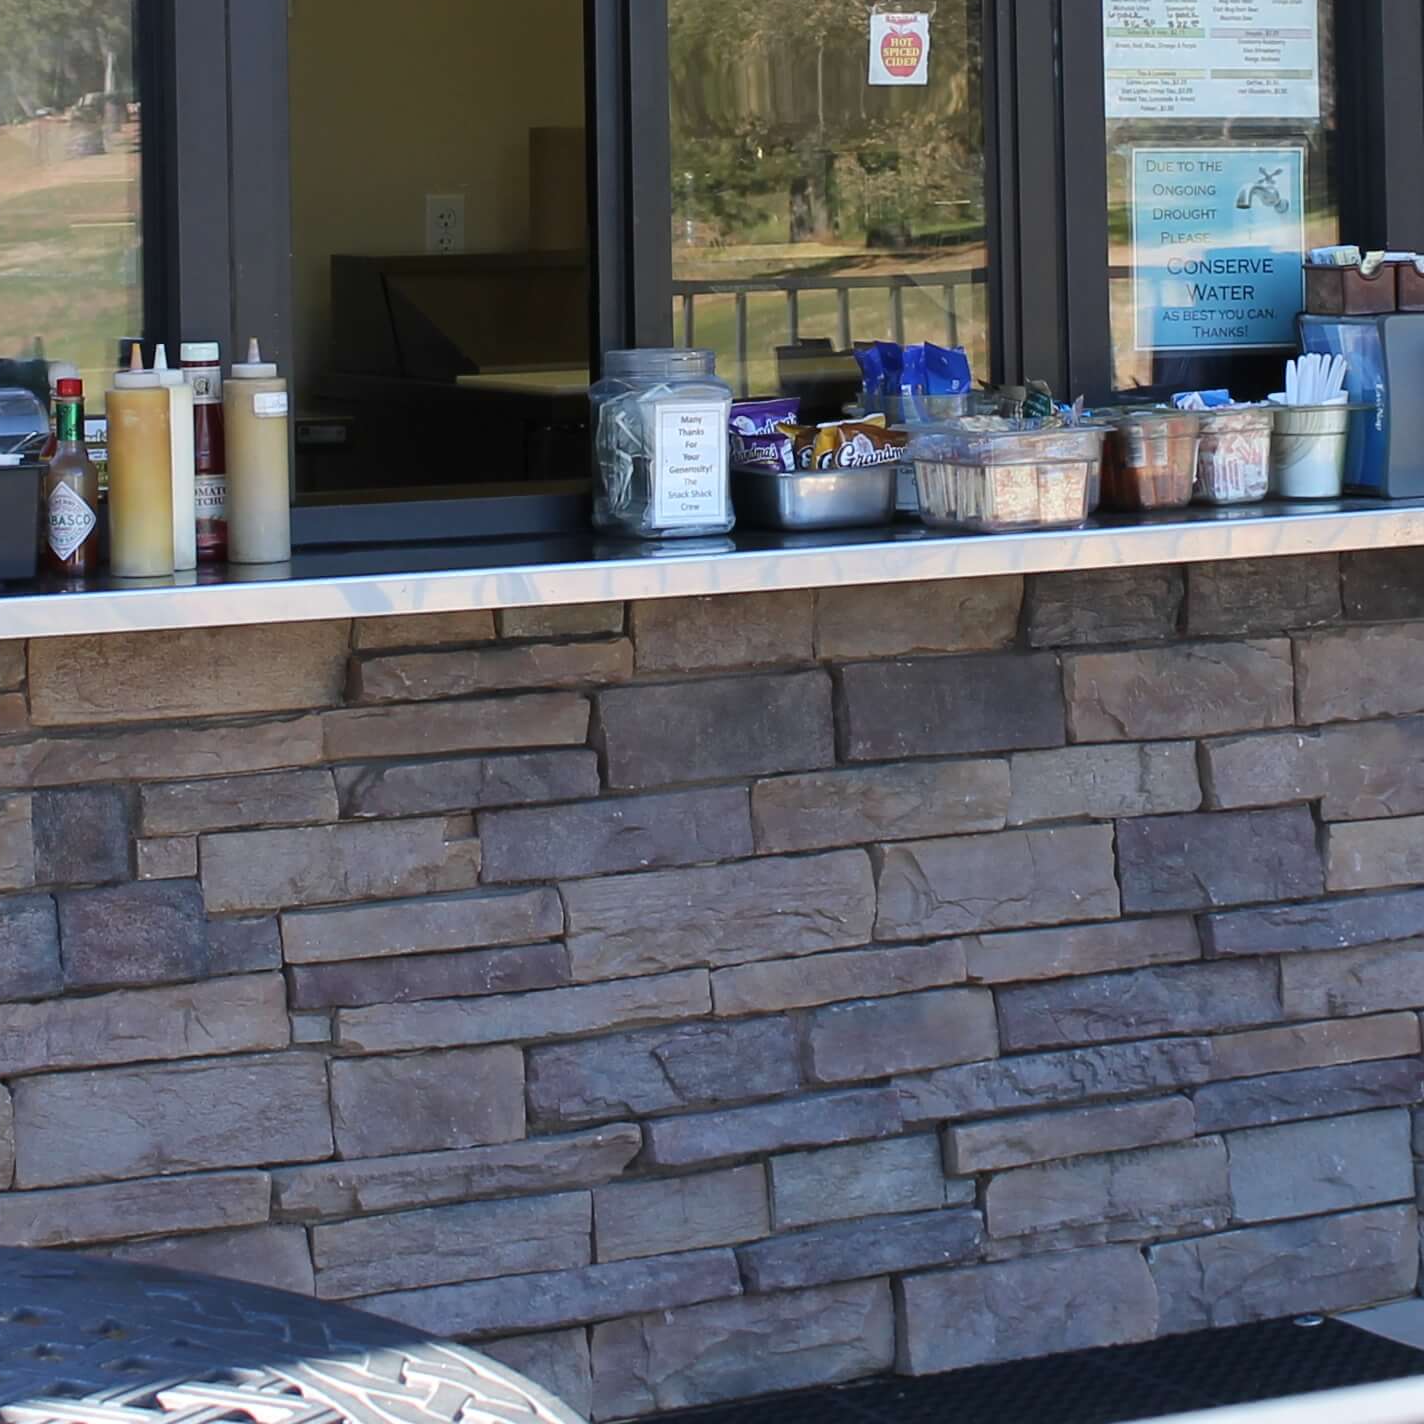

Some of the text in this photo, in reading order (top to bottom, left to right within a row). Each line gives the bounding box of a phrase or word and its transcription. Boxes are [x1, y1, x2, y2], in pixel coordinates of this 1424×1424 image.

[890, 37, 913, 47] HOT
[882, 47, 920, 57] SPICED
[885, 57, 918, 67] CIDER
